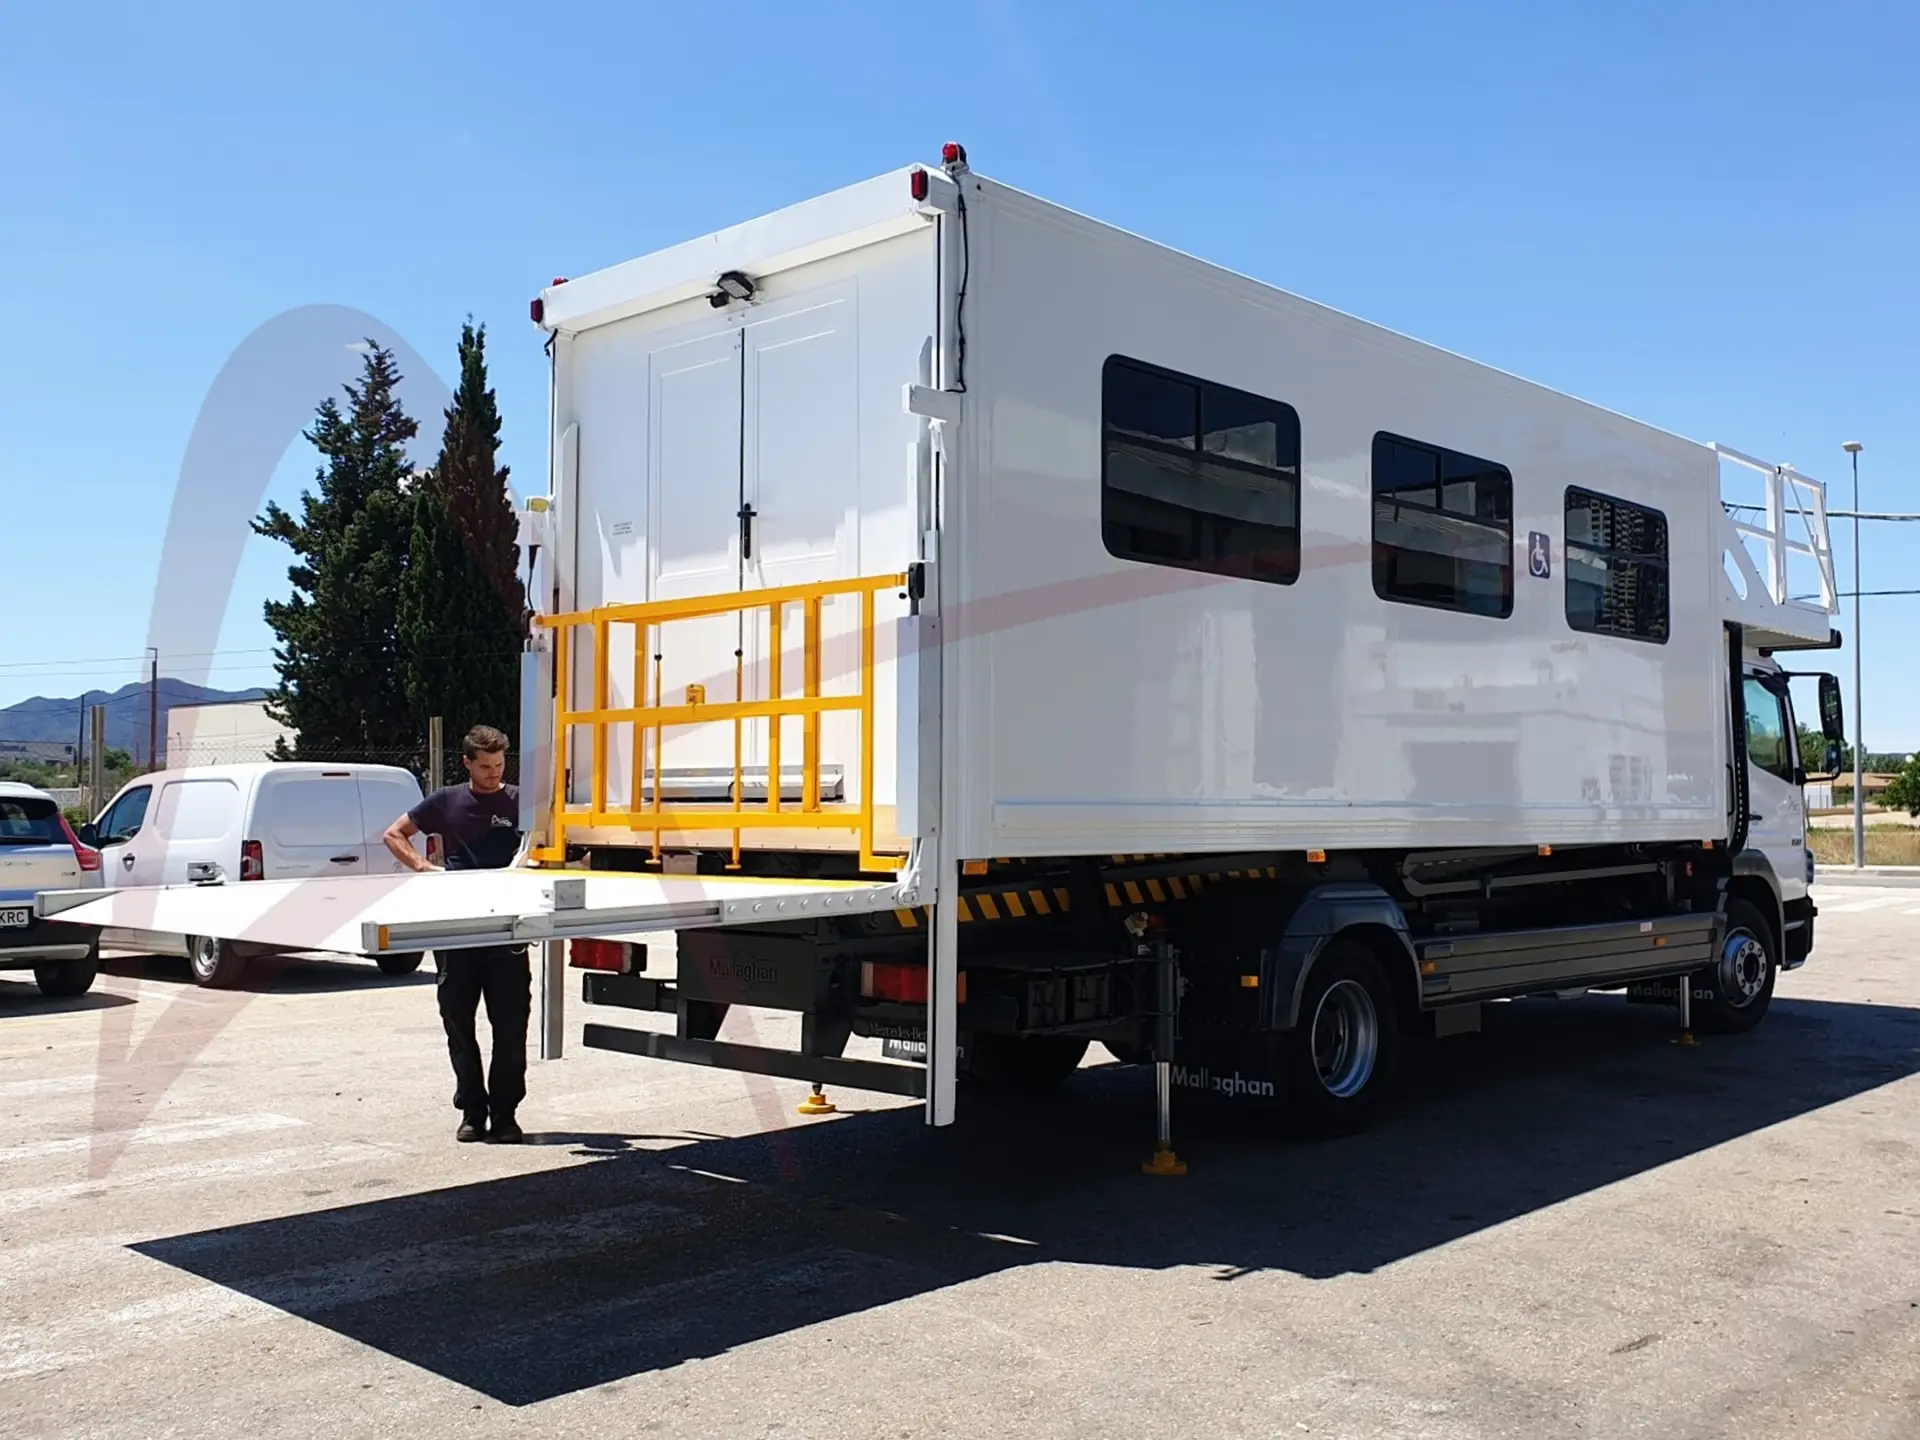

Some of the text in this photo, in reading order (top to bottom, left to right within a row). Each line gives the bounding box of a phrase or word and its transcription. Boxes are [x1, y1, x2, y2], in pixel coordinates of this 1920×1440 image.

[709, 960, 778, 982] Mallaghan
[1628, 982, 1714, 1001] Mallagan
[889, 1039, 965, 1058] Mallan
[1171, 1066, 1274, 1097] Mallaghan
